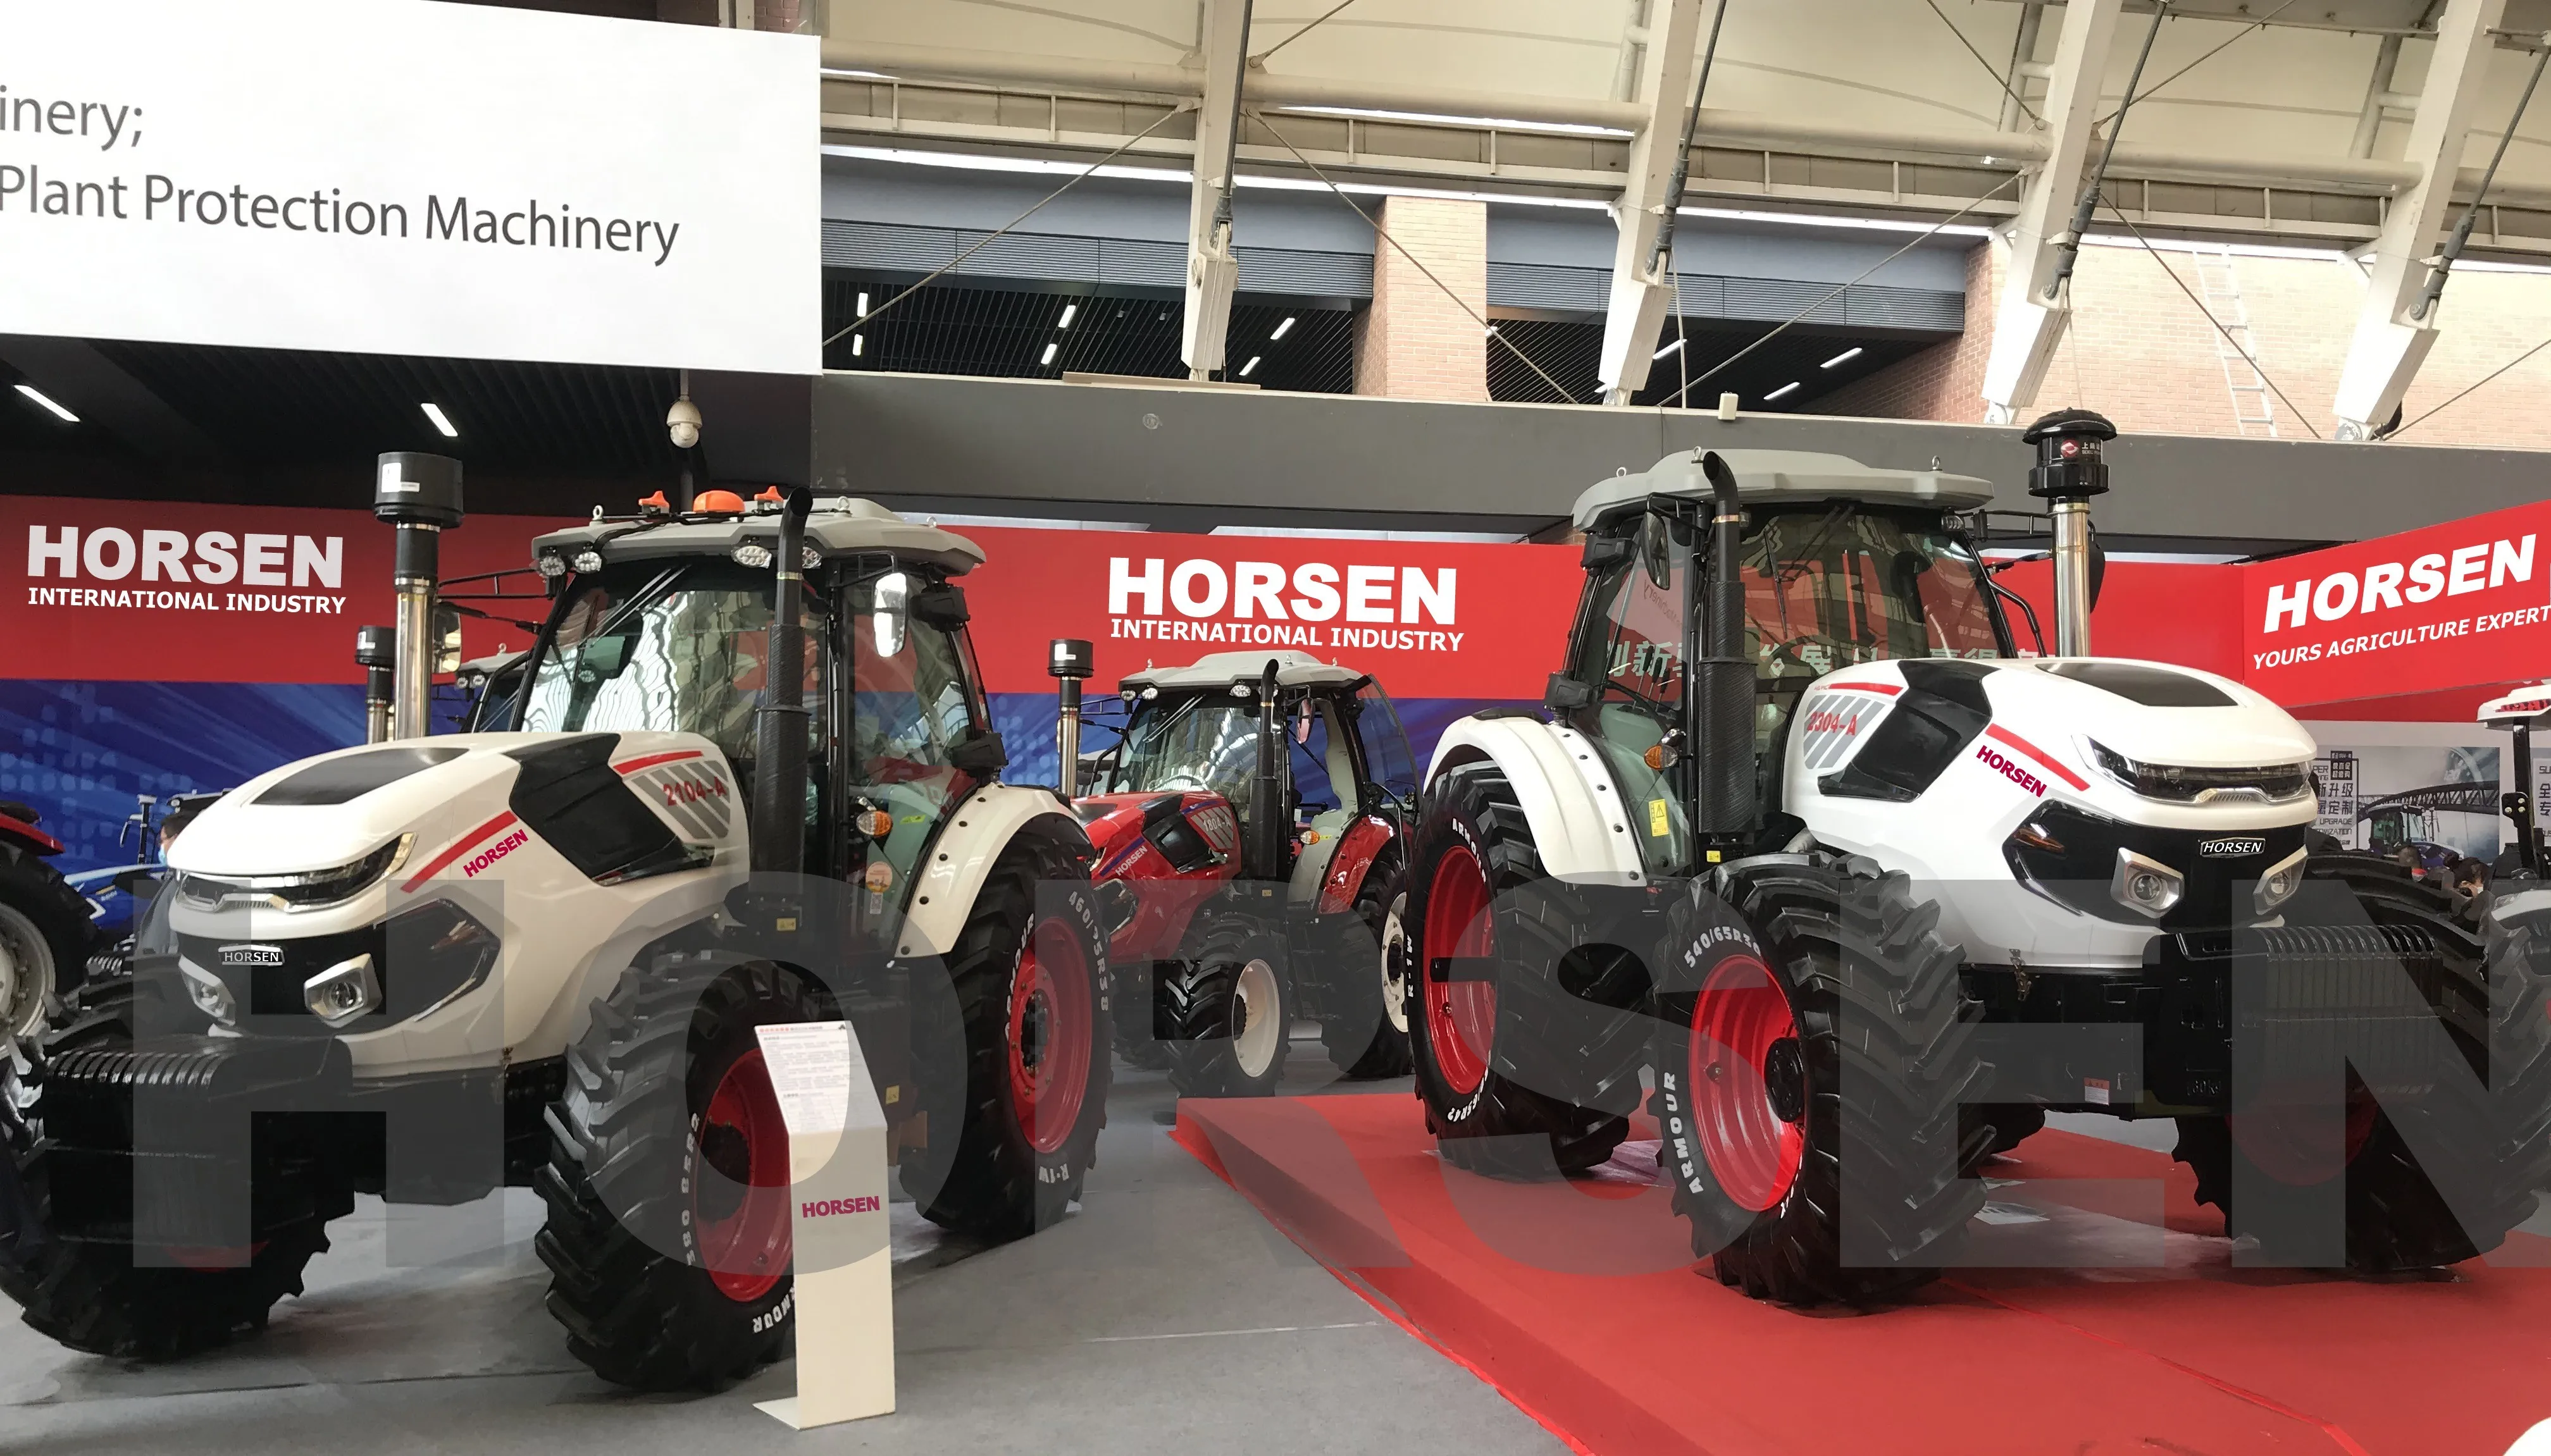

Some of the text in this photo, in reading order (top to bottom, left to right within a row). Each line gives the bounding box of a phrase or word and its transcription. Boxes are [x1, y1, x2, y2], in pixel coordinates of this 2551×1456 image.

[0, 165, 679, 267] Plant Protection Machinery
[28, 526, 342, 588] HORSEN
[28, 588, 346, 614] INTERNATIONAL INDUSTRY
[1108, 557, 1456, 625] HORSEN
[2264, 534, 2536, 634] HORSEN
[1111, 619, 1464, 651] INTERNATIONAL INDUSTRY
[2253, 643, 2321, 670] YOURS
[2326, 619, 2471, 657] AGRICULTURE
[1806, 711, 1858, 736] 2304-A
[1976, 744, 2047, 798] HORSEN
[663, 775, 727, 806] 2104-A
[1203, 815, 1231, 832] 1804-A
[462, 829, 529, 878] HORSEN
[1115, 845, 1148, 876] HORSEN
[2203, 842, 2262, 853] HORSEN
[225, 952, 278, 962] HORSEN
[1684, 926, 1761, 968] 540/65R30
[1663, 1072, 1704, 1194] ARMOUR
[802, 1195, 880, 1218] HORSEN
